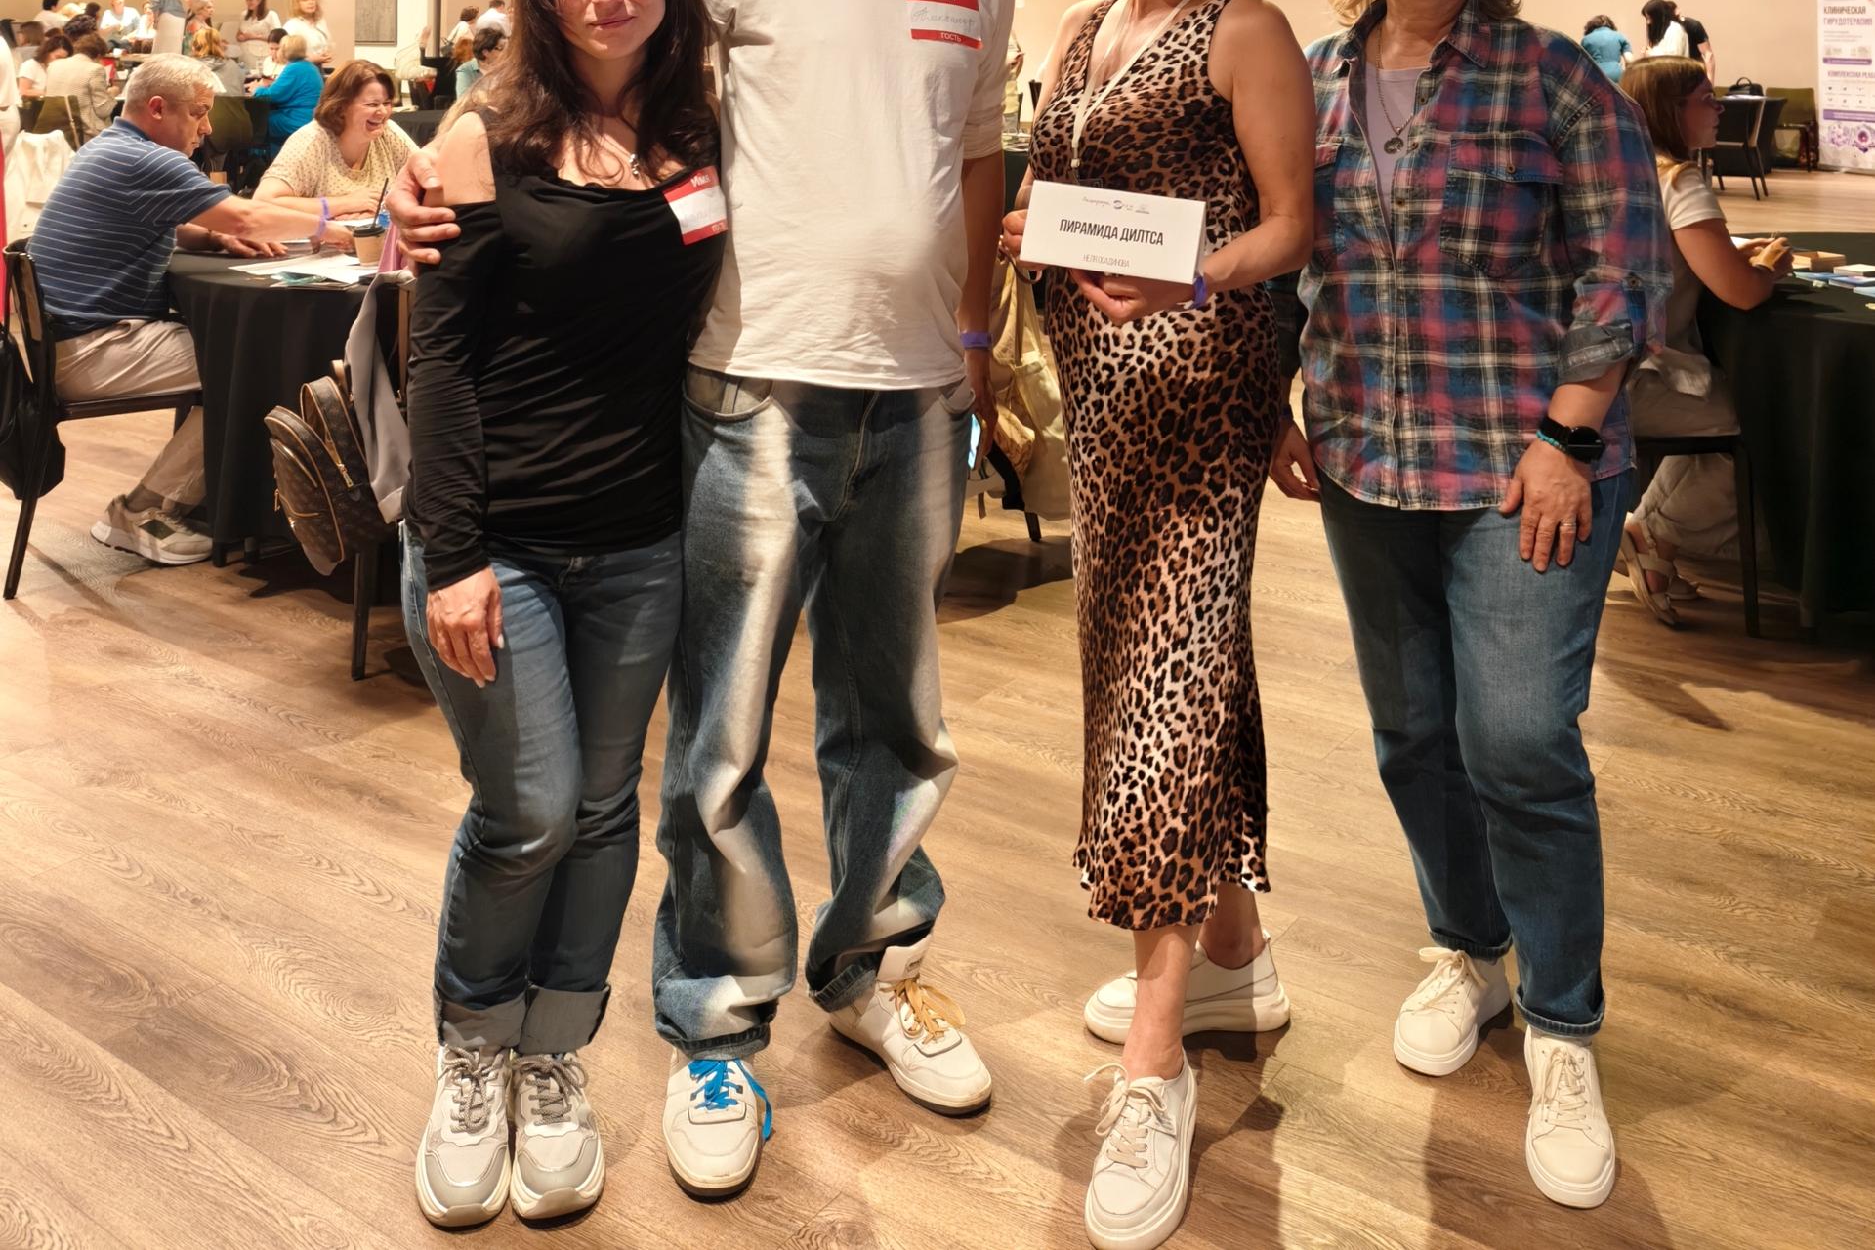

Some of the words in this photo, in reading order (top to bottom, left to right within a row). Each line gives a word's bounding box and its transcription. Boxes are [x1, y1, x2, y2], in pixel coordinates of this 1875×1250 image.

[1823, 5, 1866, 15] КЛИНИЧЕСКАЯ
[1059, 218, 1119, 240] ПИРАМИДА
[1119, 227, 1164, 246] ДИЛТСА
